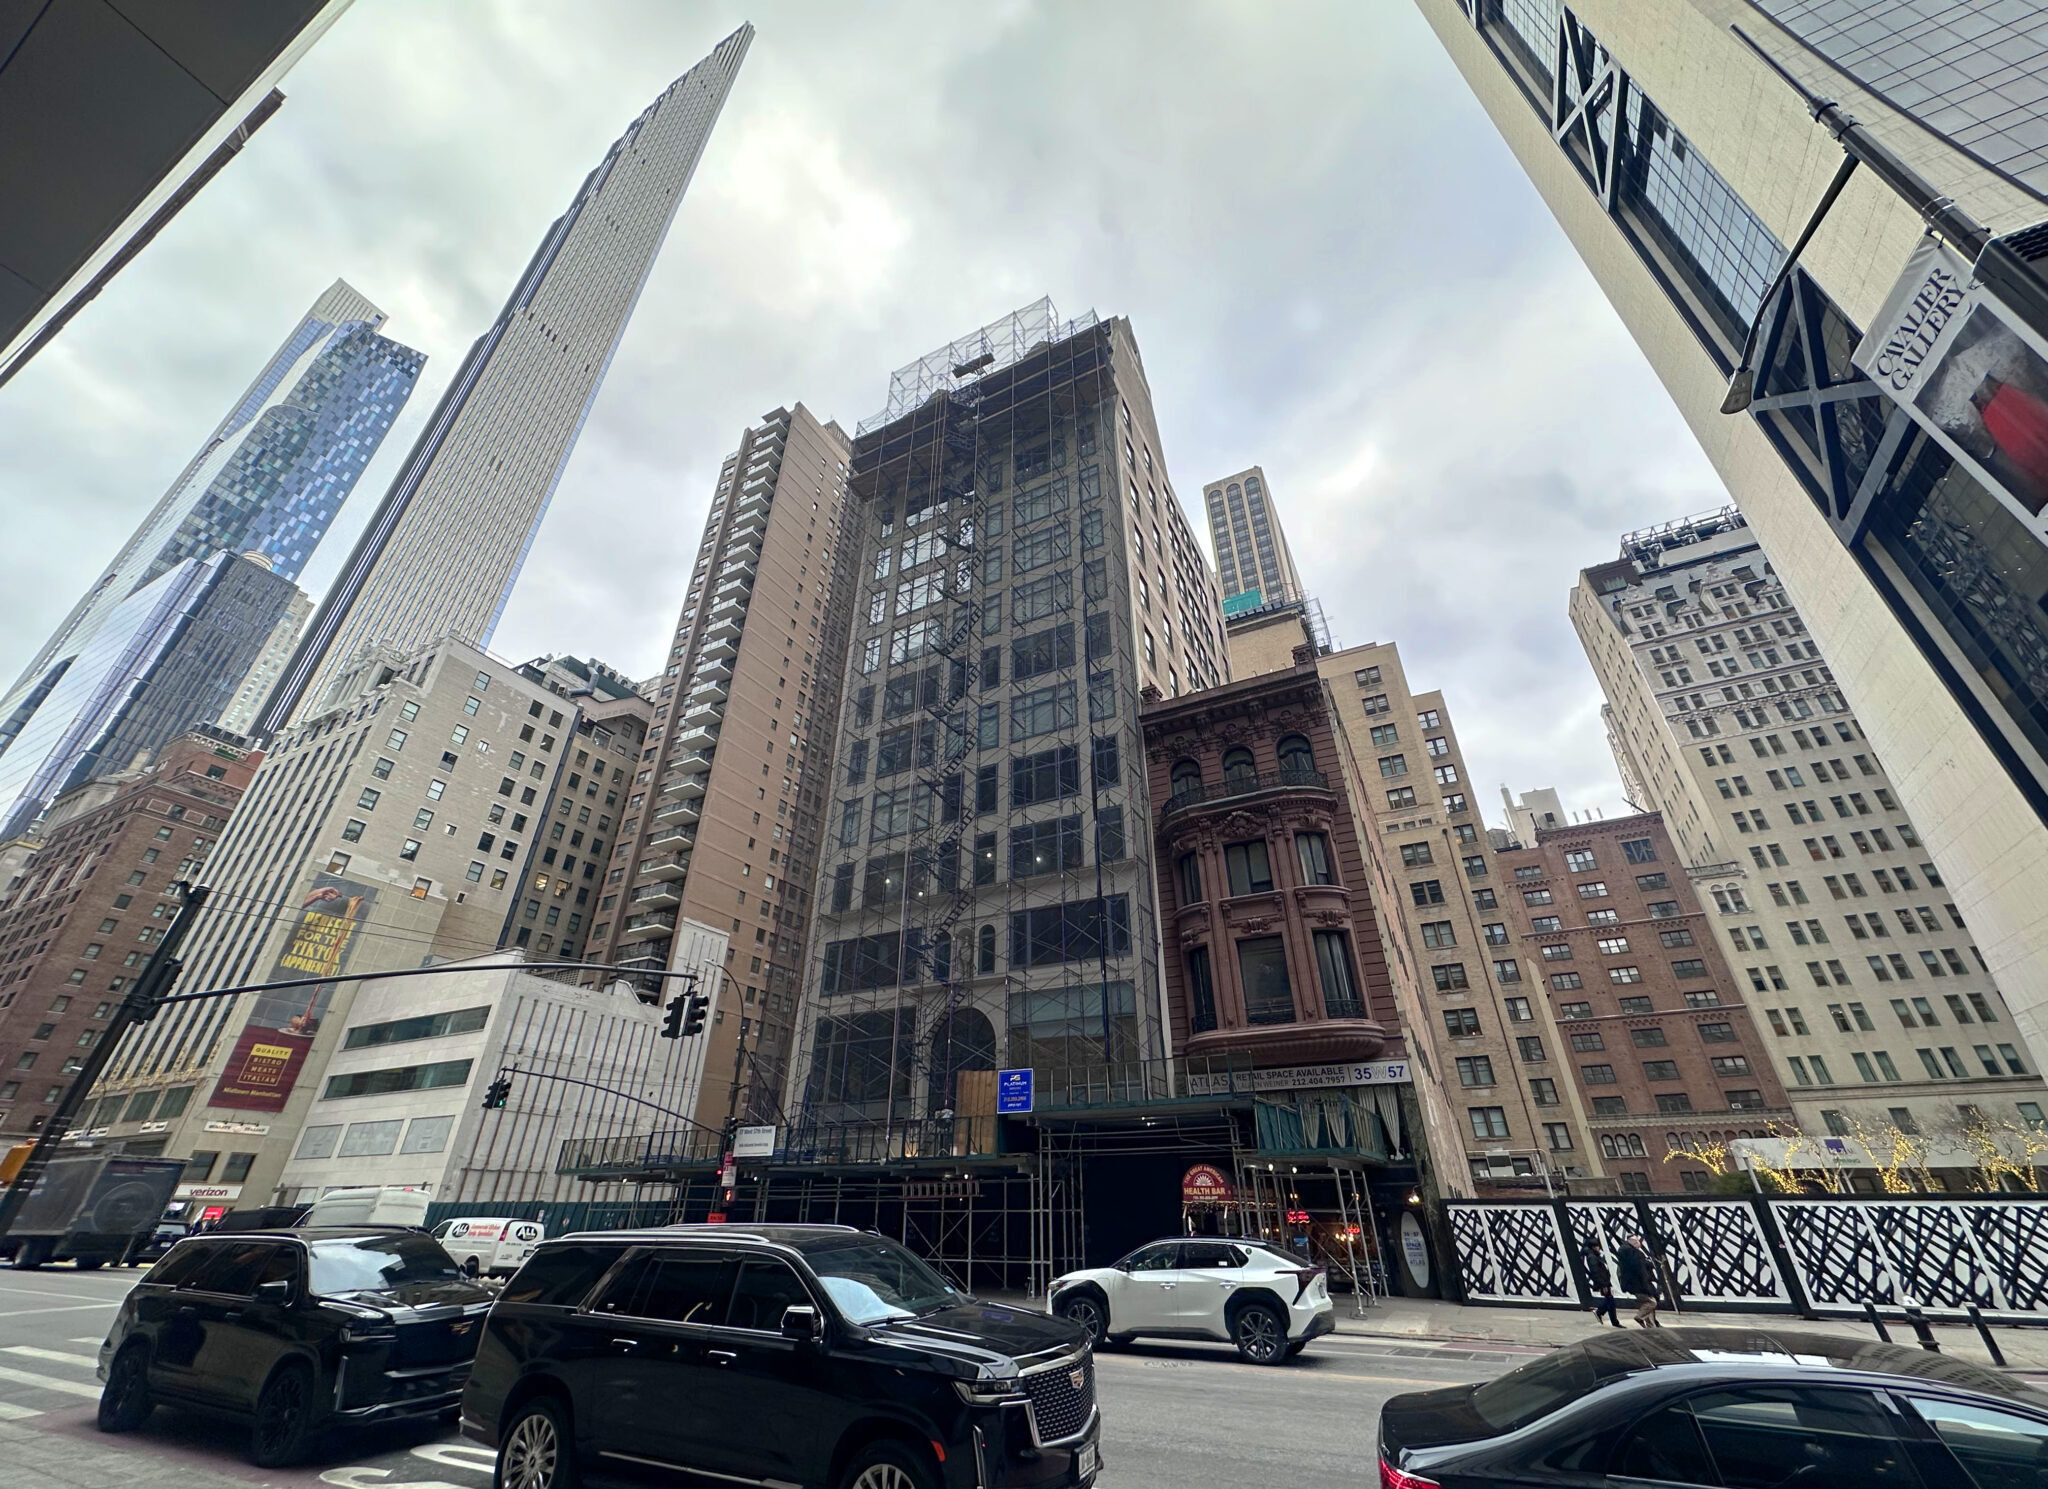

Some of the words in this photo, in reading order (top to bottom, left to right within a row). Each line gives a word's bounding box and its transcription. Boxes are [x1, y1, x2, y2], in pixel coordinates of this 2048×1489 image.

[1877, 268, 1952, 376] CAVALIER
[1892, 277, 1966, 391] GALLERY
[297, 929, 322, 942] FOR
[324, 935, 349, 949] THE
[291, 940, 344, 963] TIKTOK
[280, 953, 341, 976] (APPARENY)
[255, 1047, 289, 1056] QUALITY
[253, 1057, 283, 1066] BISTRO
[250, 1066, 277, 1074] MEATS
[1236, 1072, 1265, 1081] RETAIL
[1266, 1070, 1294, 1080] SPACE
[1296, 1066, 1345, 1077] AVAILABLE
[1354, 1065, 1405, 1080] 35W57
[243, 1074, 277, 1084] ITALIAN
[1190, 1075, 1229, 1088] ATLAS
[1292, 1075, 1345, 1086] 212.404.7957
[190, 1187, 229, 1197] verizon
[1184, 1187, 1210, 1195] HEALTH
[1211, 1187, 1226, 1195] BAR
[453, 1223, 469, 1235] ALL
[518, 1225, 537, 1237] ALL
